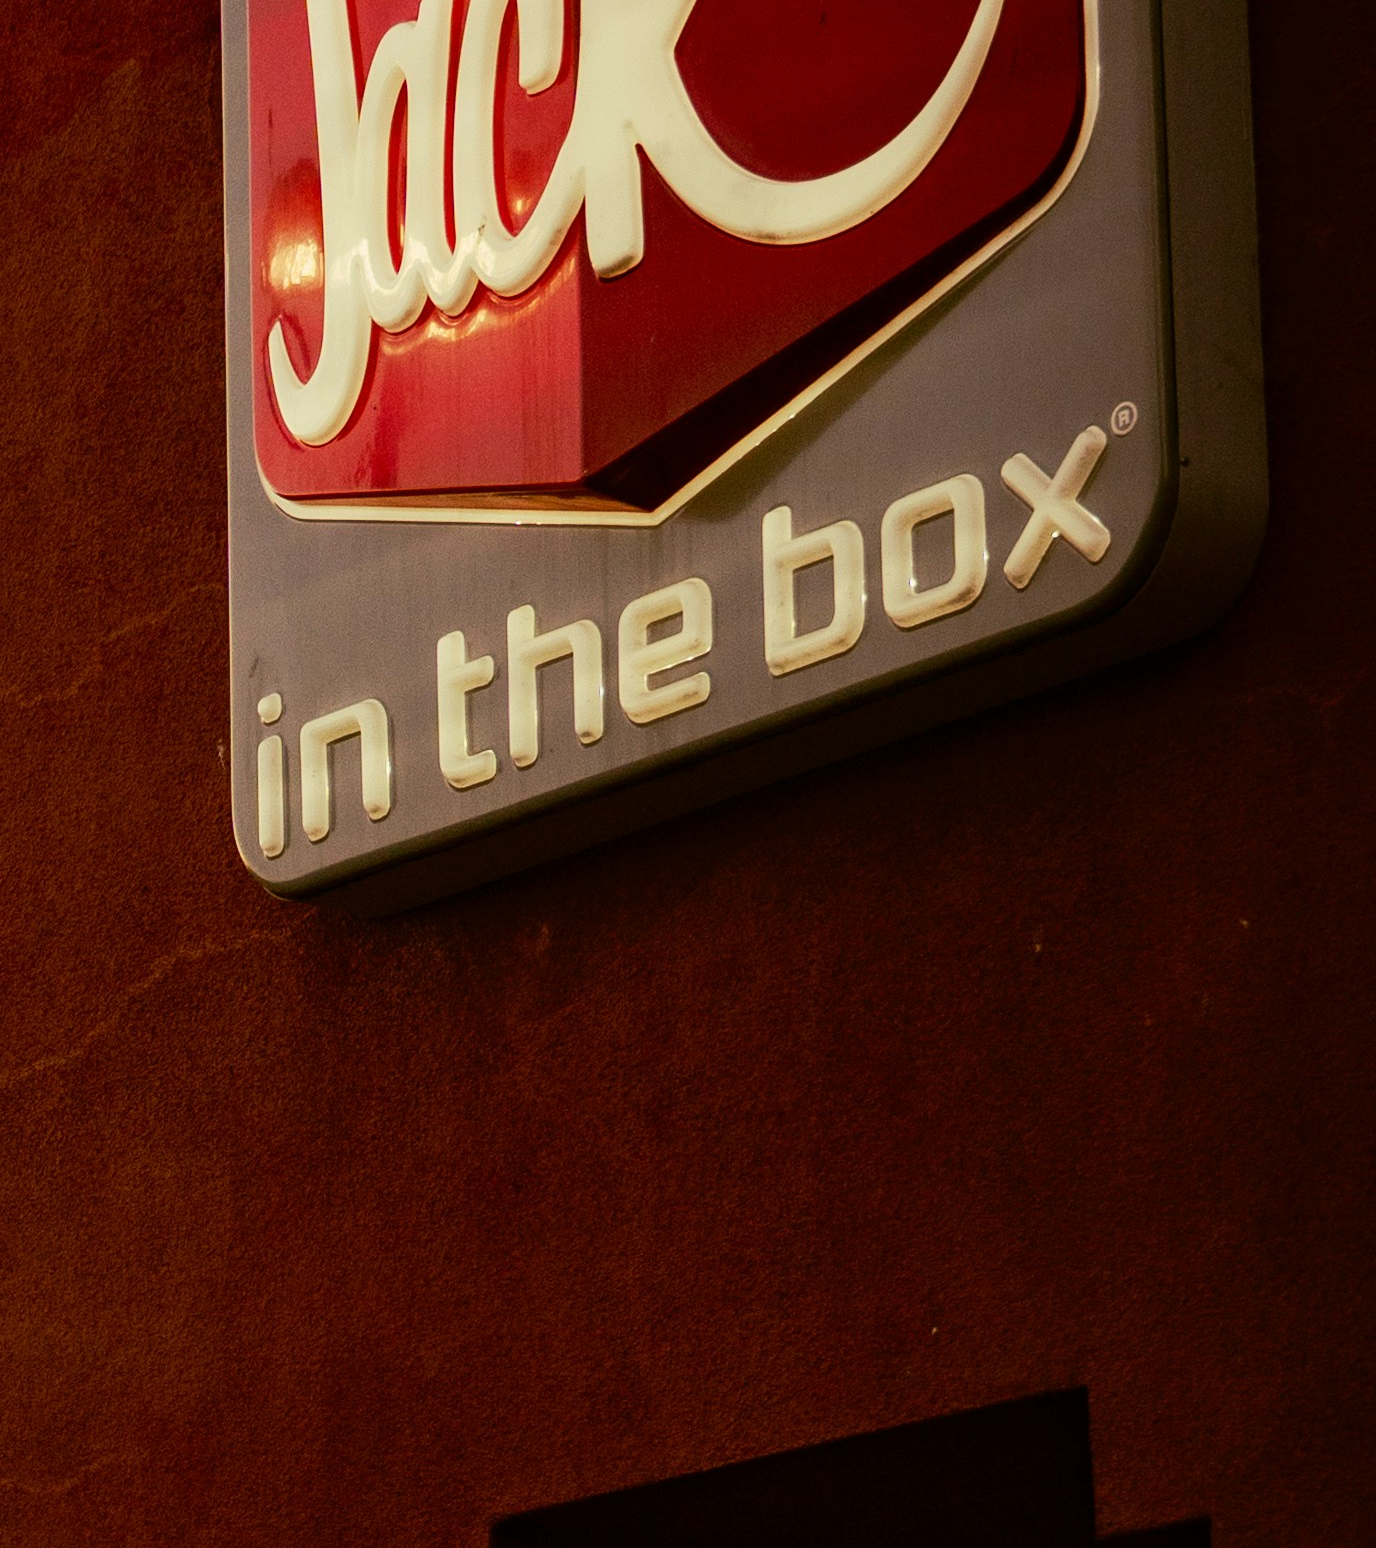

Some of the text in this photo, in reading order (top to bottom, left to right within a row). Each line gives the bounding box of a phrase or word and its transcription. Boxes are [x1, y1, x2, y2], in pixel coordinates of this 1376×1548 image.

[257, 425, 1111, 858] in the box
